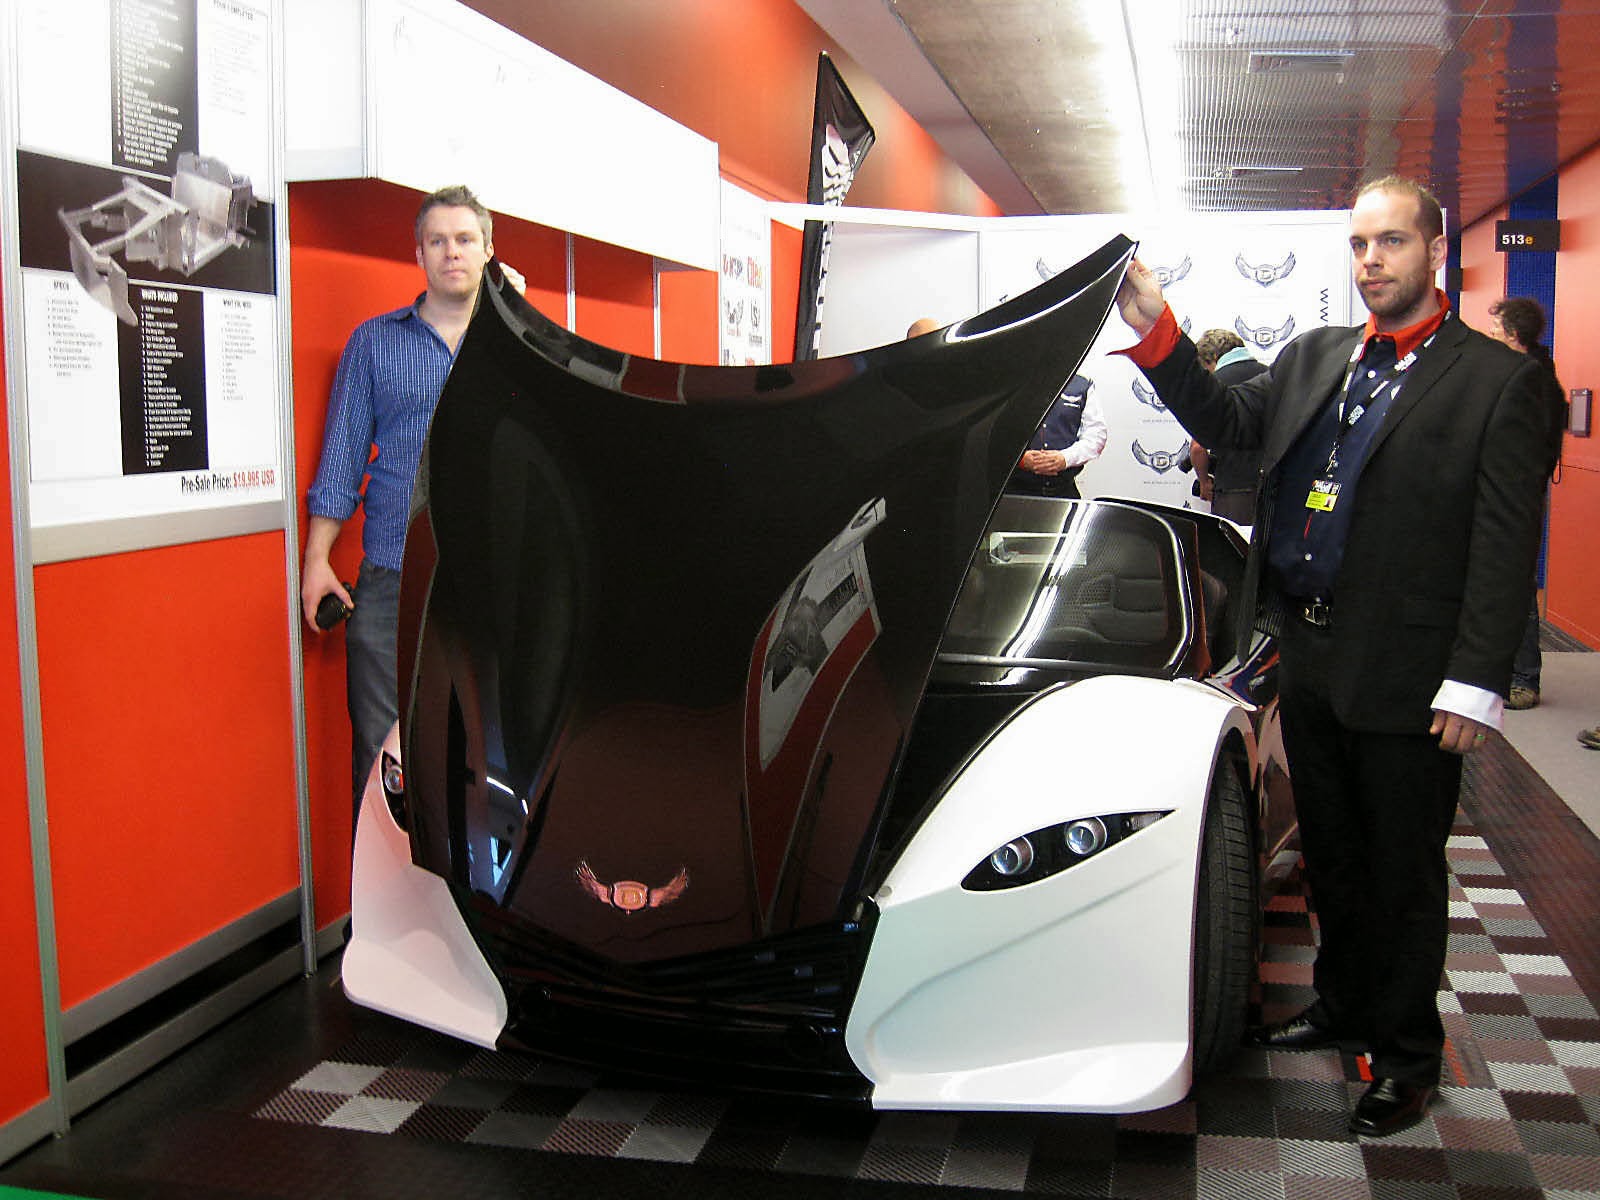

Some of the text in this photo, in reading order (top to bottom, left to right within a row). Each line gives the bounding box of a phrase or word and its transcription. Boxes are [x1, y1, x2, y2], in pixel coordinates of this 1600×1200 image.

[1502, 234, 1534, 246] 513e
[181, 475, 210, 493] Pre-Sale
[212, 473, 232, 491] Price:
[261, 468, 275, 486] USD
